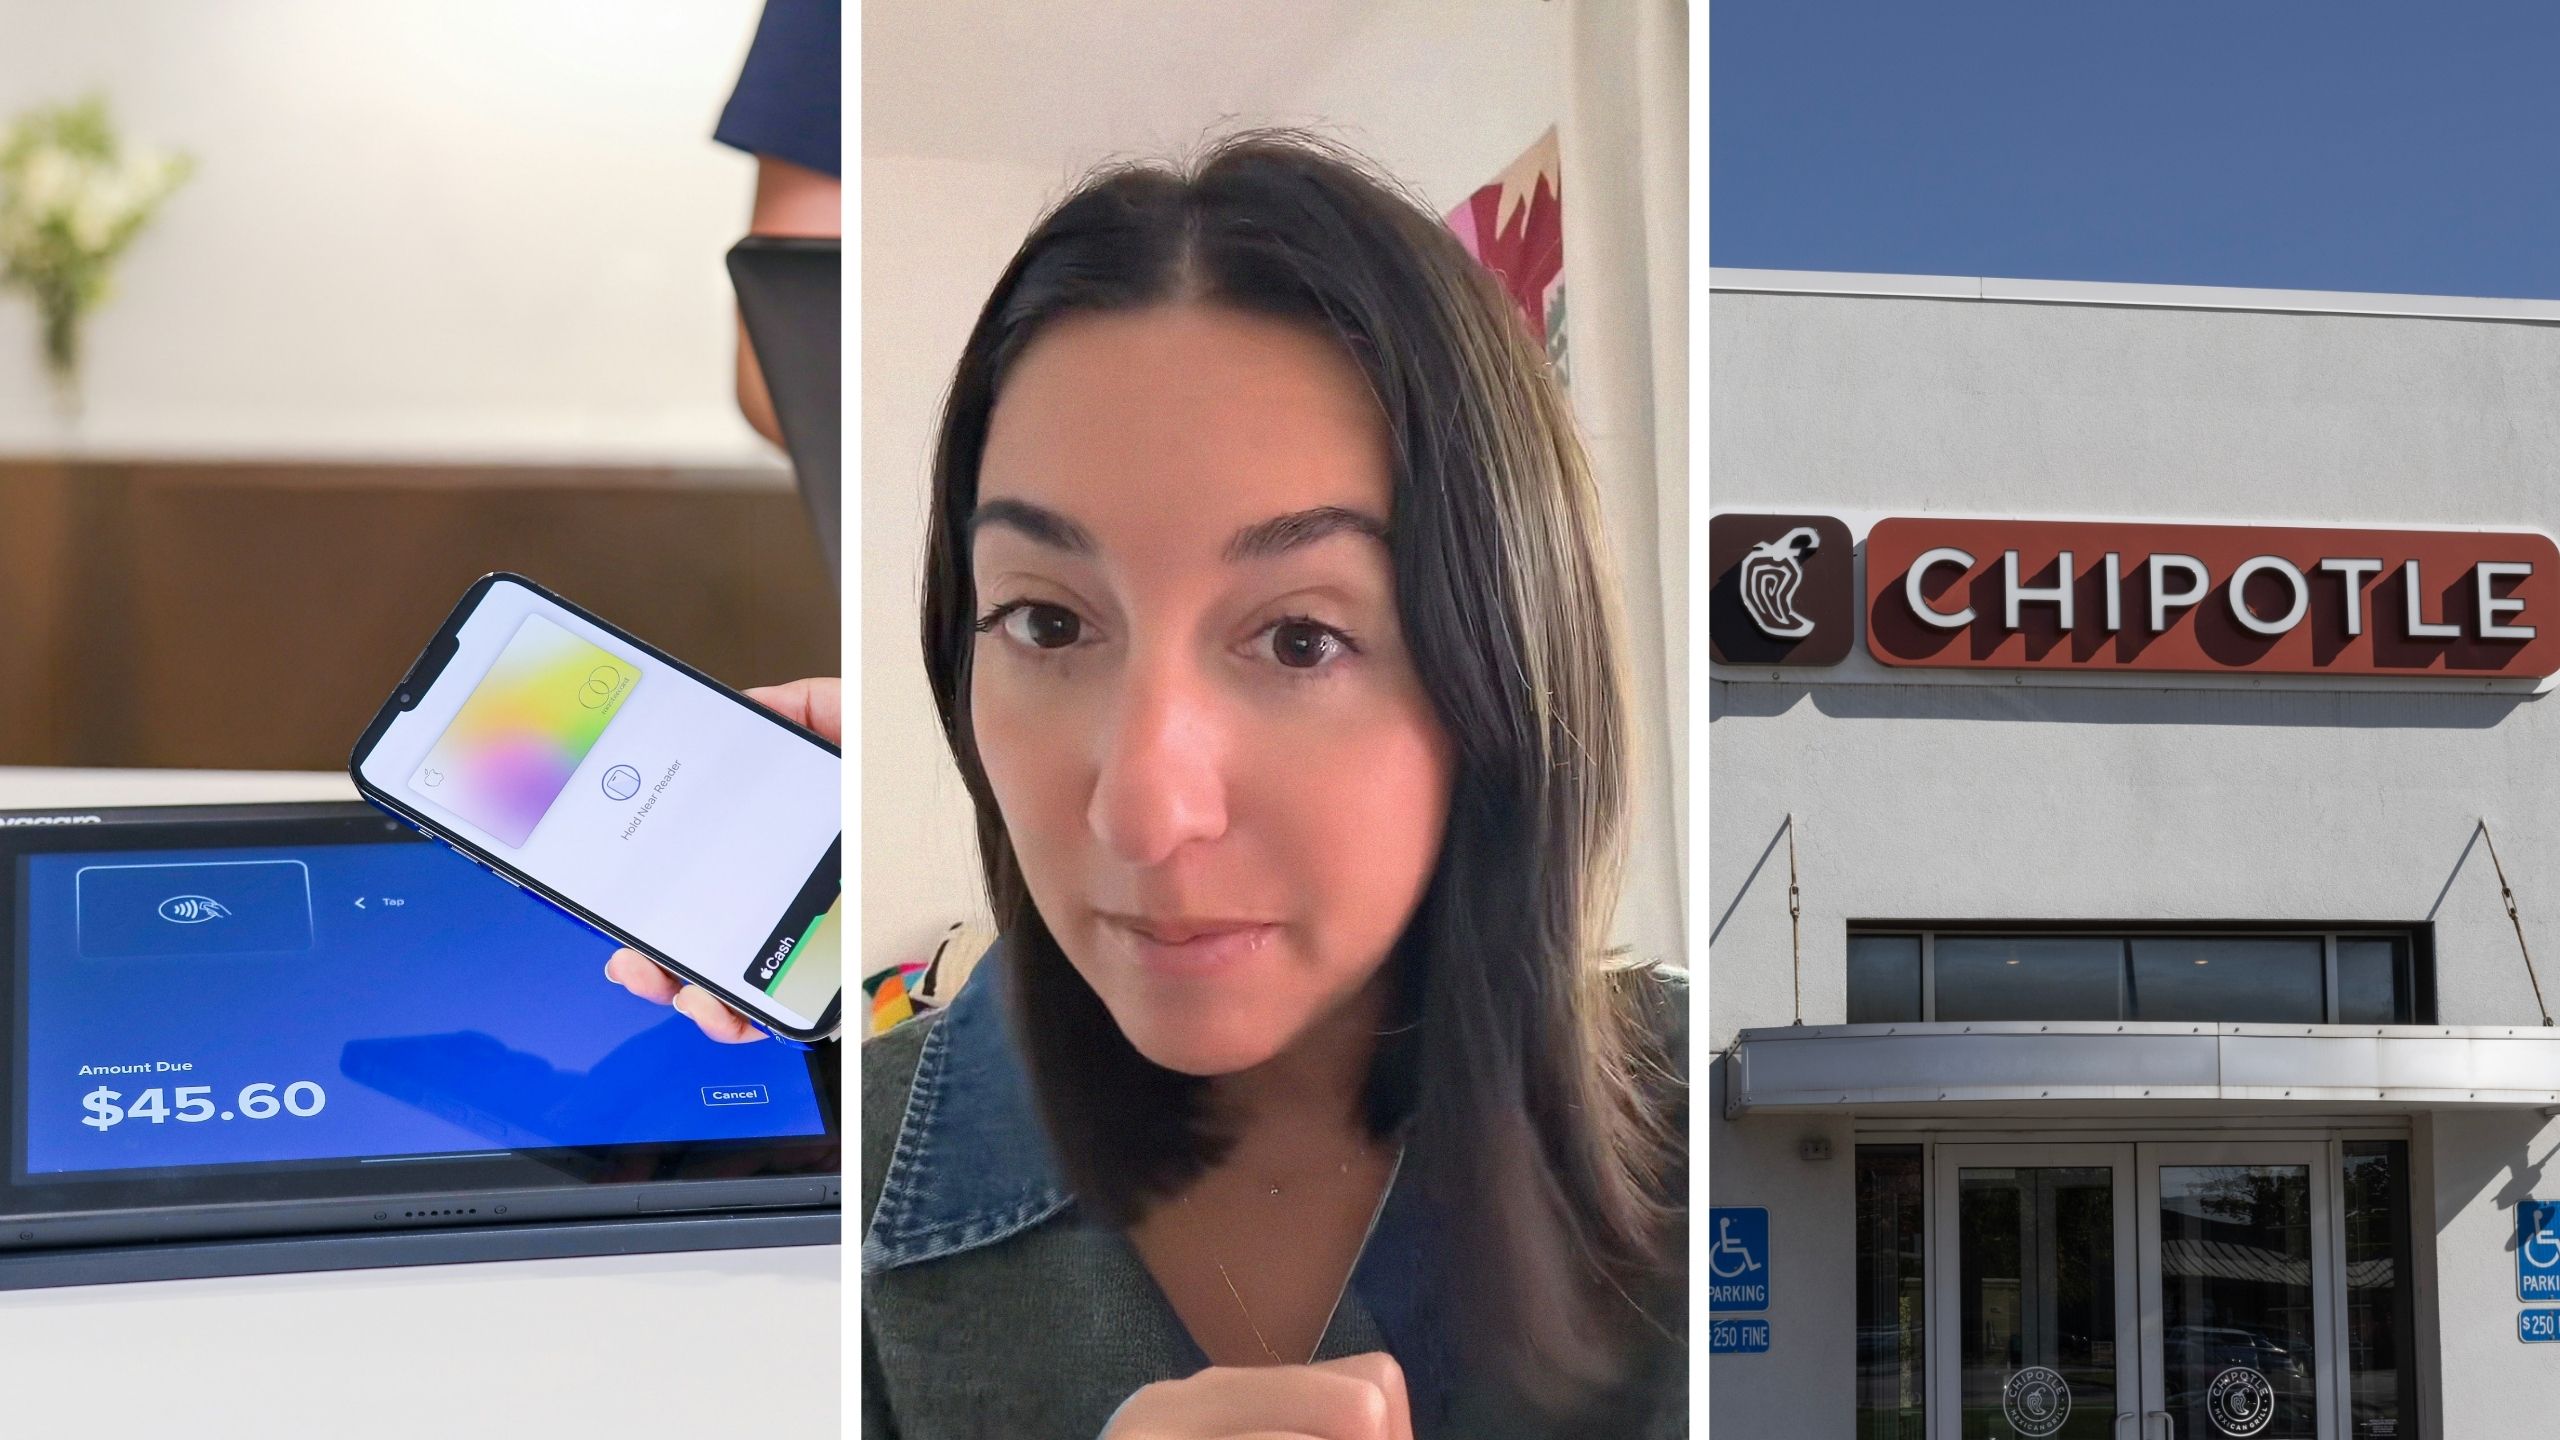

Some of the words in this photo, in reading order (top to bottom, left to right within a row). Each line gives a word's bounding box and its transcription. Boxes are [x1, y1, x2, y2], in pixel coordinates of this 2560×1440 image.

[1905, 546, 2536, 639] CHIPOTLE
[620, 816, 642, 841] Hold
[637, 794, 658, 818] Near
[653, 759, 682, 793] Reader
[382, 897, 405, 907] Tap
[766, 937, 796, 970] Cash
[78, 1062, 151, 1076] Amount
[156, 1061, 193, 1072] Due
[81, 1080, 326, 1132] $45.60
[712, 1090, 757, 1100] Cancel
[1709, 1284, 1765, 1302] PARKING
[1742, 1326, 1768, 1347] FINE
[2008, 1371, 2065, 1397] CHIPOTLE
[2213, 1371, 2269, 1397] CHIPOTLE
[2011, 1409, 2045, 1431] MEXICAN
[2046, 1406, 2066, 1428] GRILL
[2214, 1408, 2248, 1431] MEXICAN
[2249, 1407, 2268, 1428] GRILL
